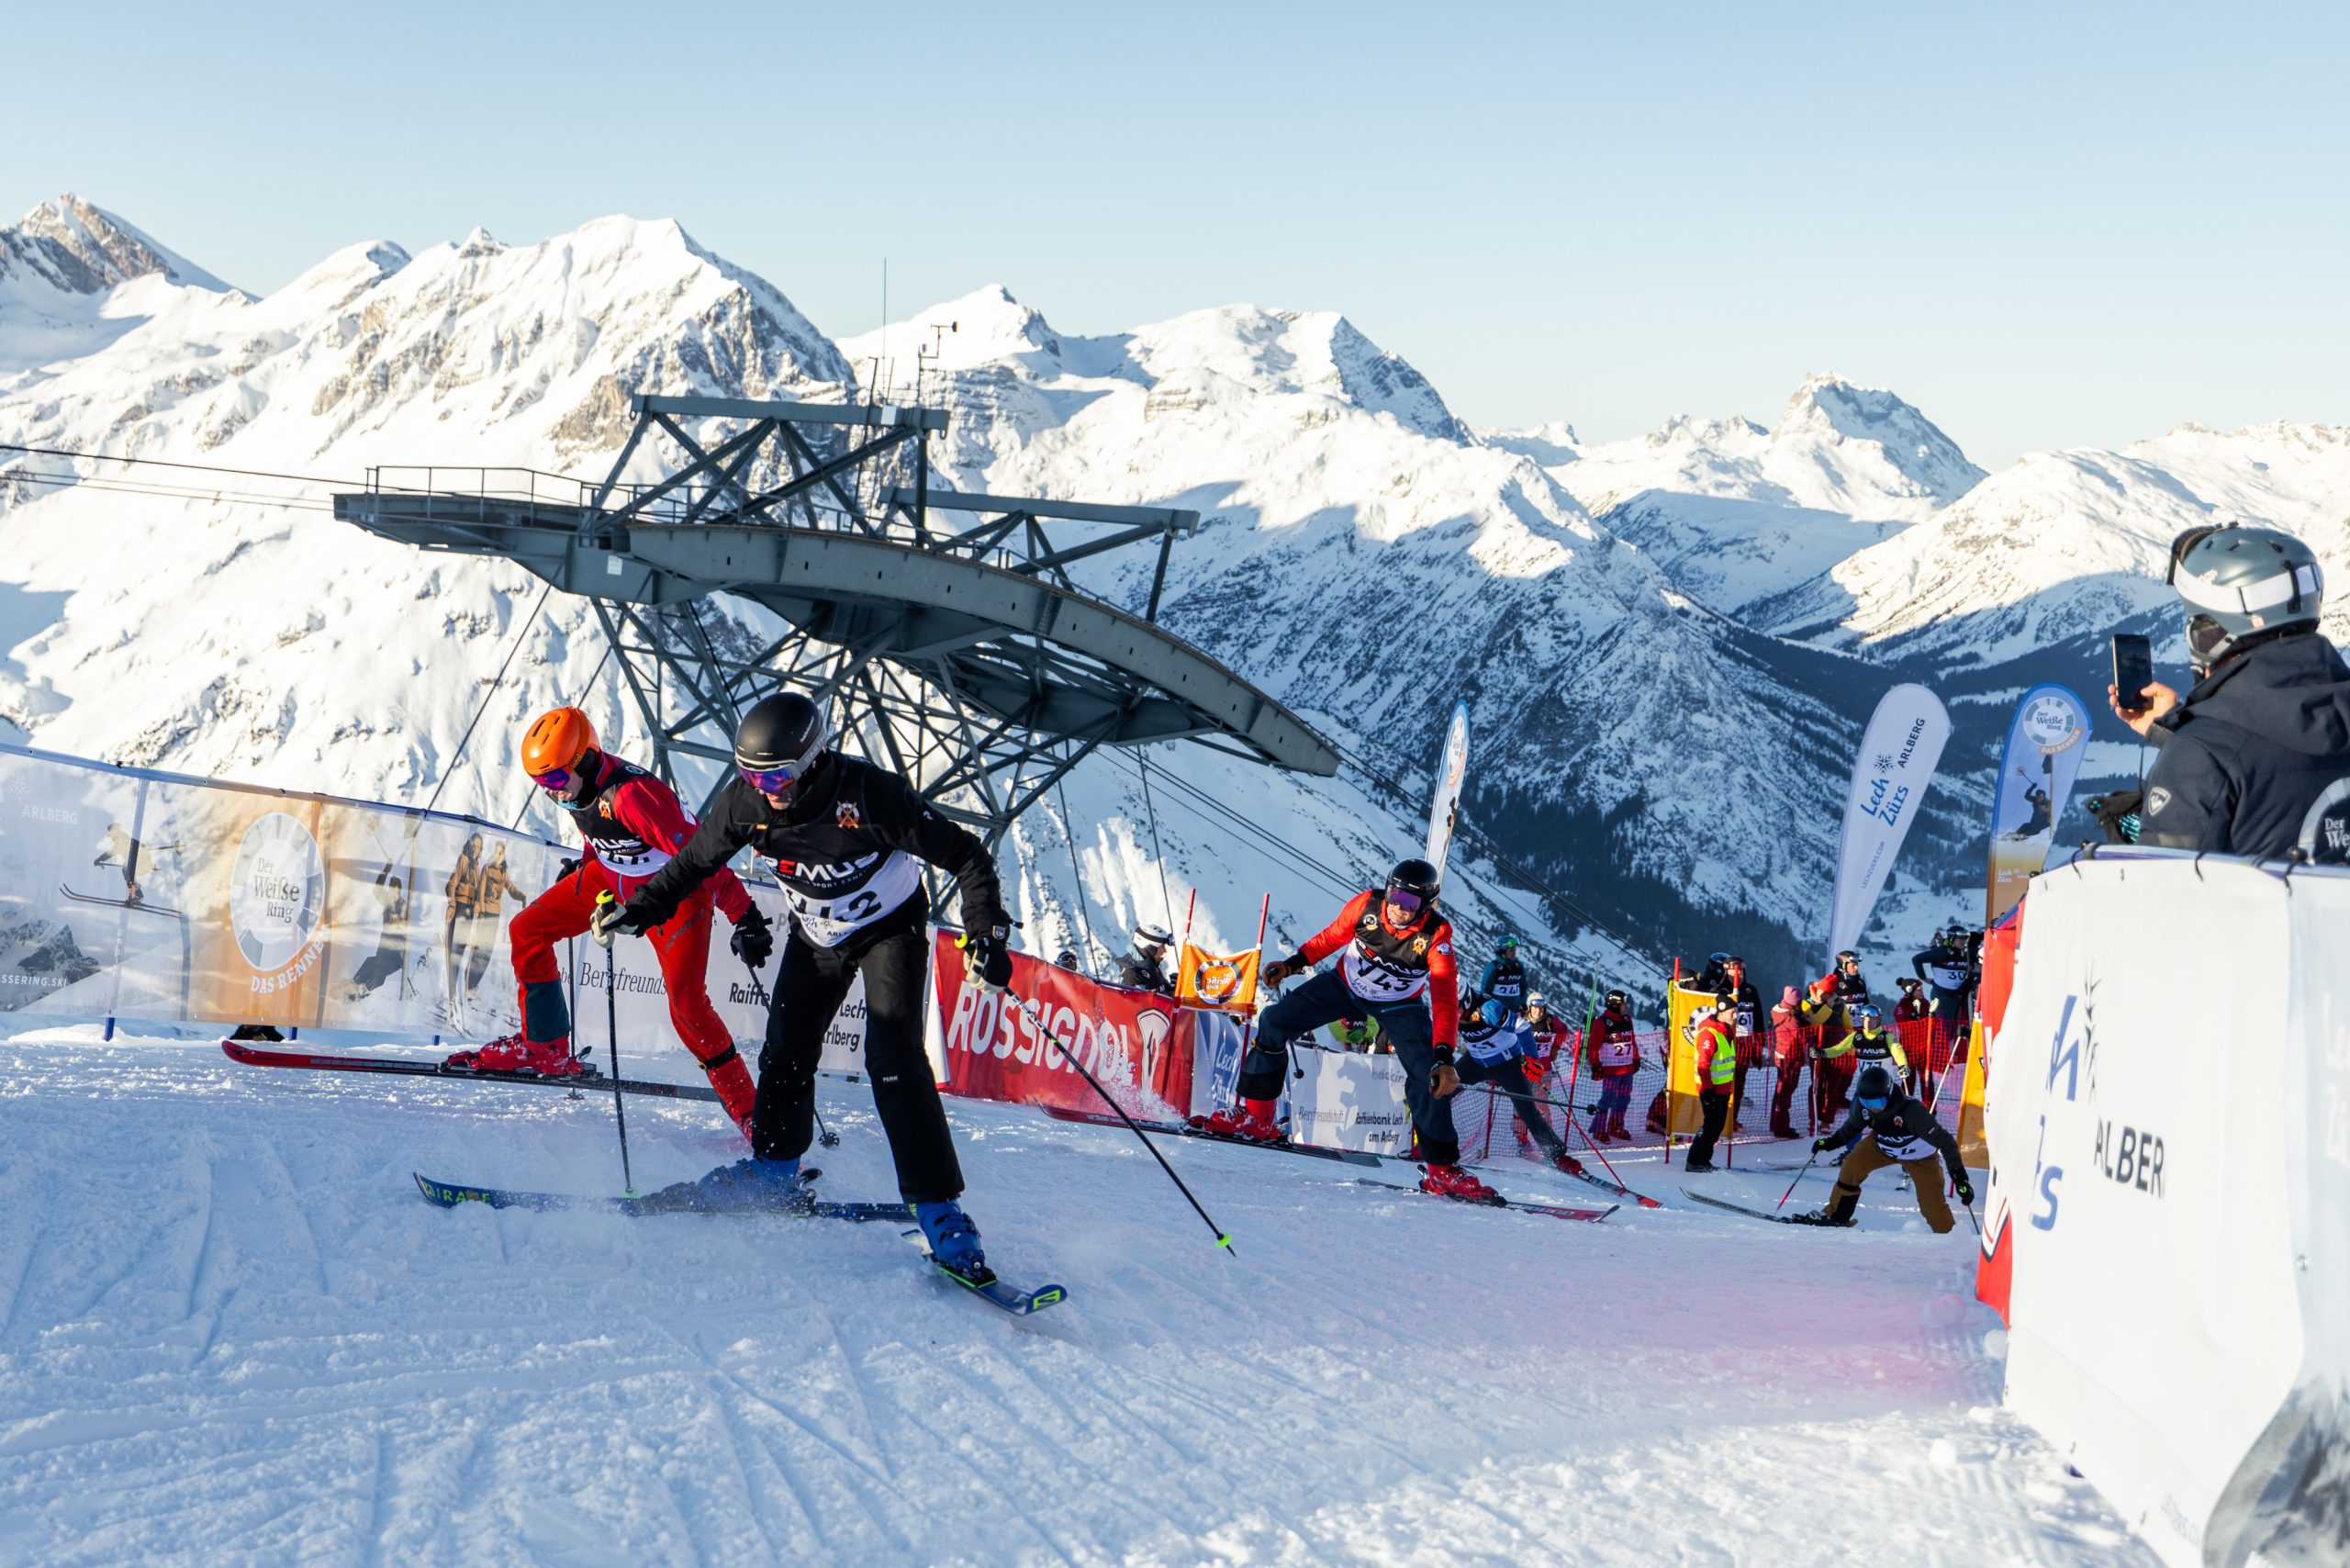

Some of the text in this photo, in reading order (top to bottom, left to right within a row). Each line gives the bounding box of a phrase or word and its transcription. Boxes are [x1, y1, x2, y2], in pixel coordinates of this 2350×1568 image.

[2036, 716, 2064, 724] Weiße
[1897, 717, 1926, 768] ARLBERG
[1860, 778, 1890, 817] Lech
[1879, 785, 1909, 826] Zürs
[22, 804, 78, 825] ARLBERG
[2324, 818, 2344, 831] Der
[258, 857, 274, 874] Der
[1862, 841, 1886, 890] LECHZUERS.COM
[253, 875, 300, 902] Weiße
[266, 902, 294, 923] Ring
[251, 976, 275, 993] DAS
[1948, 971, 1966, 980] 30
[947, 980, 1134, 1086] ROSSIGNOL
[1615, 1044, 1631, 1056] 27
